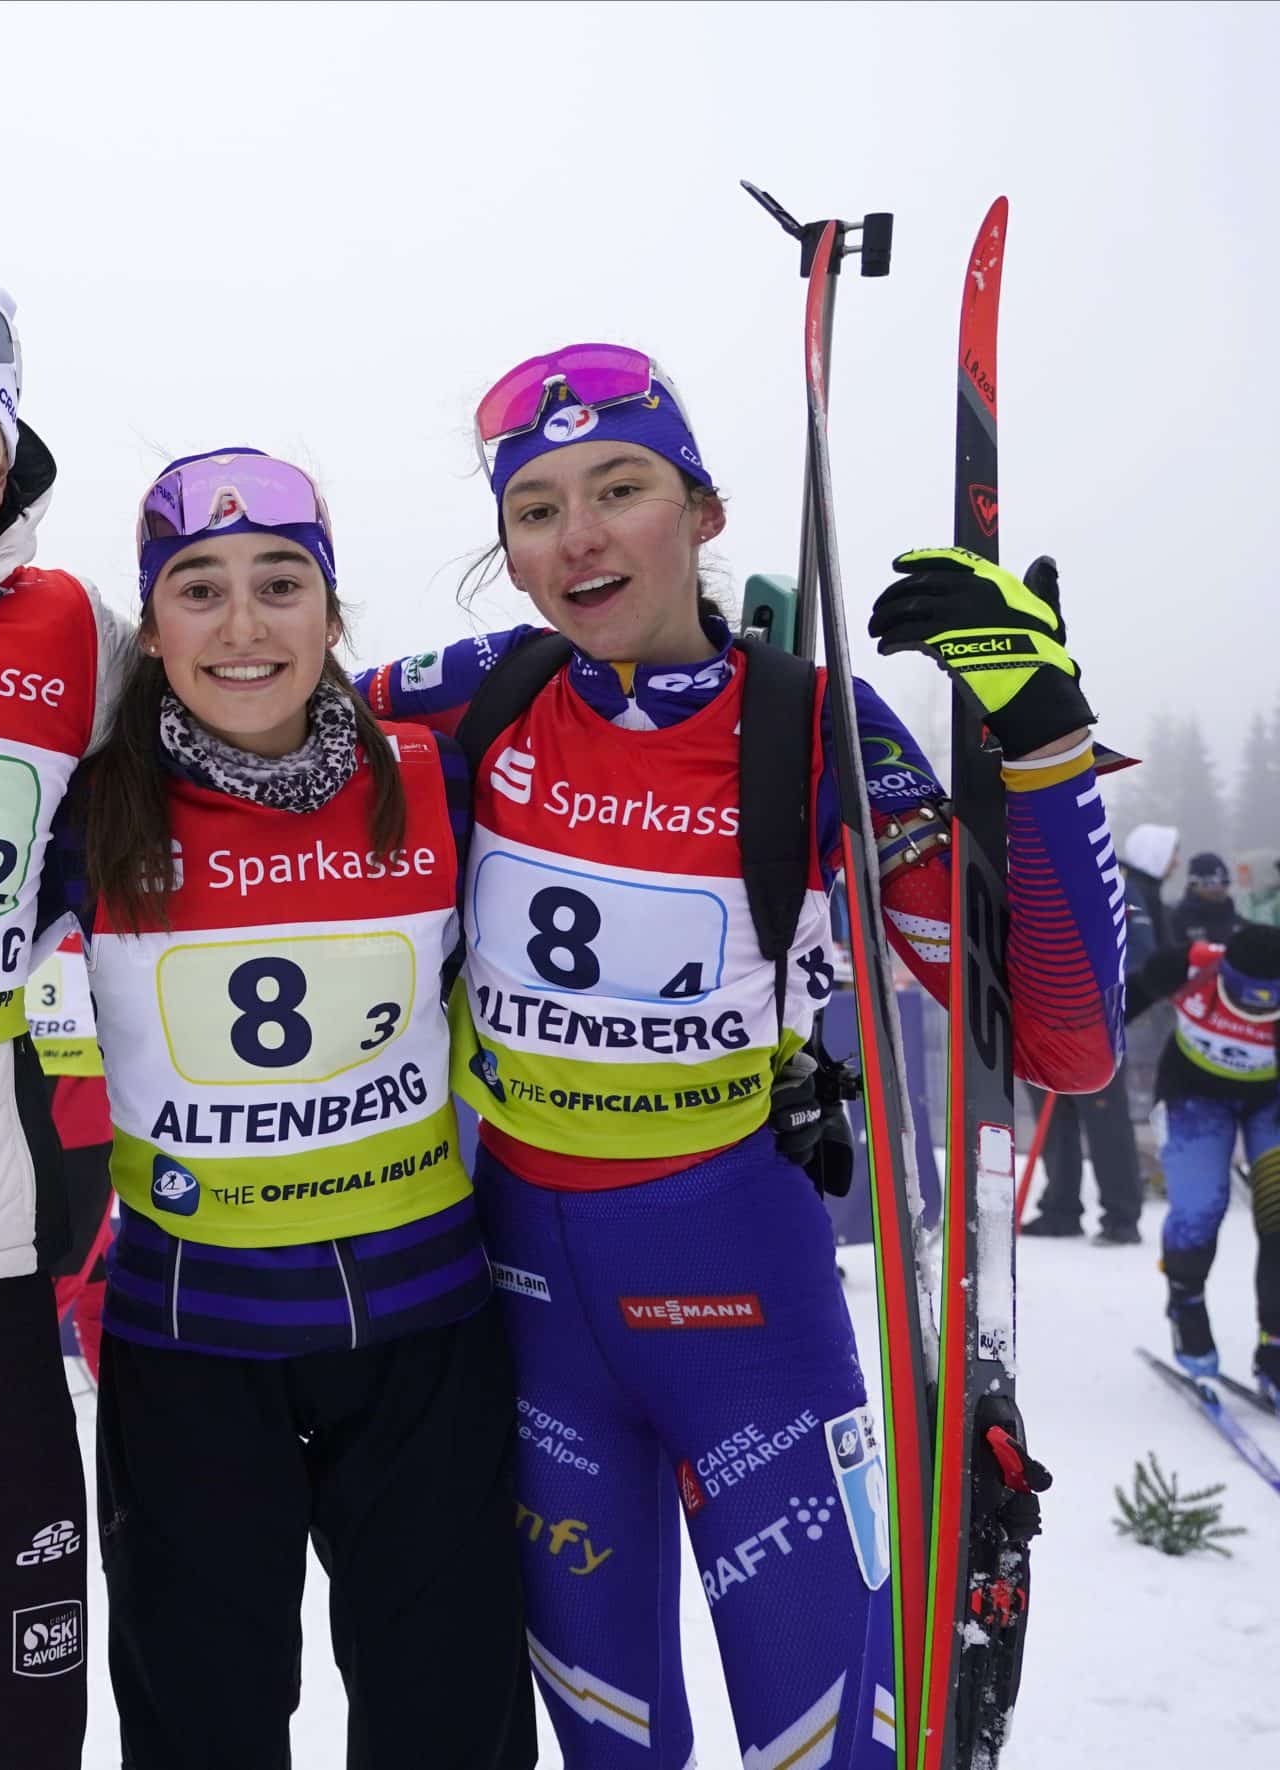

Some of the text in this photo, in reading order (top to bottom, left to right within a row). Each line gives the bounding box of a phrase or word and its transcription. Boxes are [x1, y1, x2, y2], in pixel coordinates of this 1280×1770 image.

[866, 770, 918, 796] ROY
[543, 780, 740, 838] Sparkass
[207, 840, 437, 897] Sparkasse
[527, 885, 704, 998] 8 4
[41, 983, 57, 1007] 3
[227, 955, 402, 1068] 8 3
[29, 1018, 78, 1037] ERG
[150, 1062, 428, 1145] ALTENBERG
[509, 1078, 547, 1104] THE
[549, 1089, 670, 1114] OFFICIAL
[674, 1084, 721, 1107] IBU
[210, 1141, 450, 1205] THE OFFICIAL IBU APP
[516, 1274, 548, 1296] Lain
[628, 1298, 754, 1326] VIESSMANN
[516, 1396, 584, 1443] ergne-
[519, 1424, 601, 1476] e-Alpes
[696, 1423, 766, 1477] CAISSE
[705, 1409, 821, 1499] D'EPARGNE
[15, 1534, 81, 1567] GSG
[703, 1515, 793, 1607] RAFT
[23, 1643, 68, 1667] SAVOIE
[49, 1616, 78, 1646] SKI
